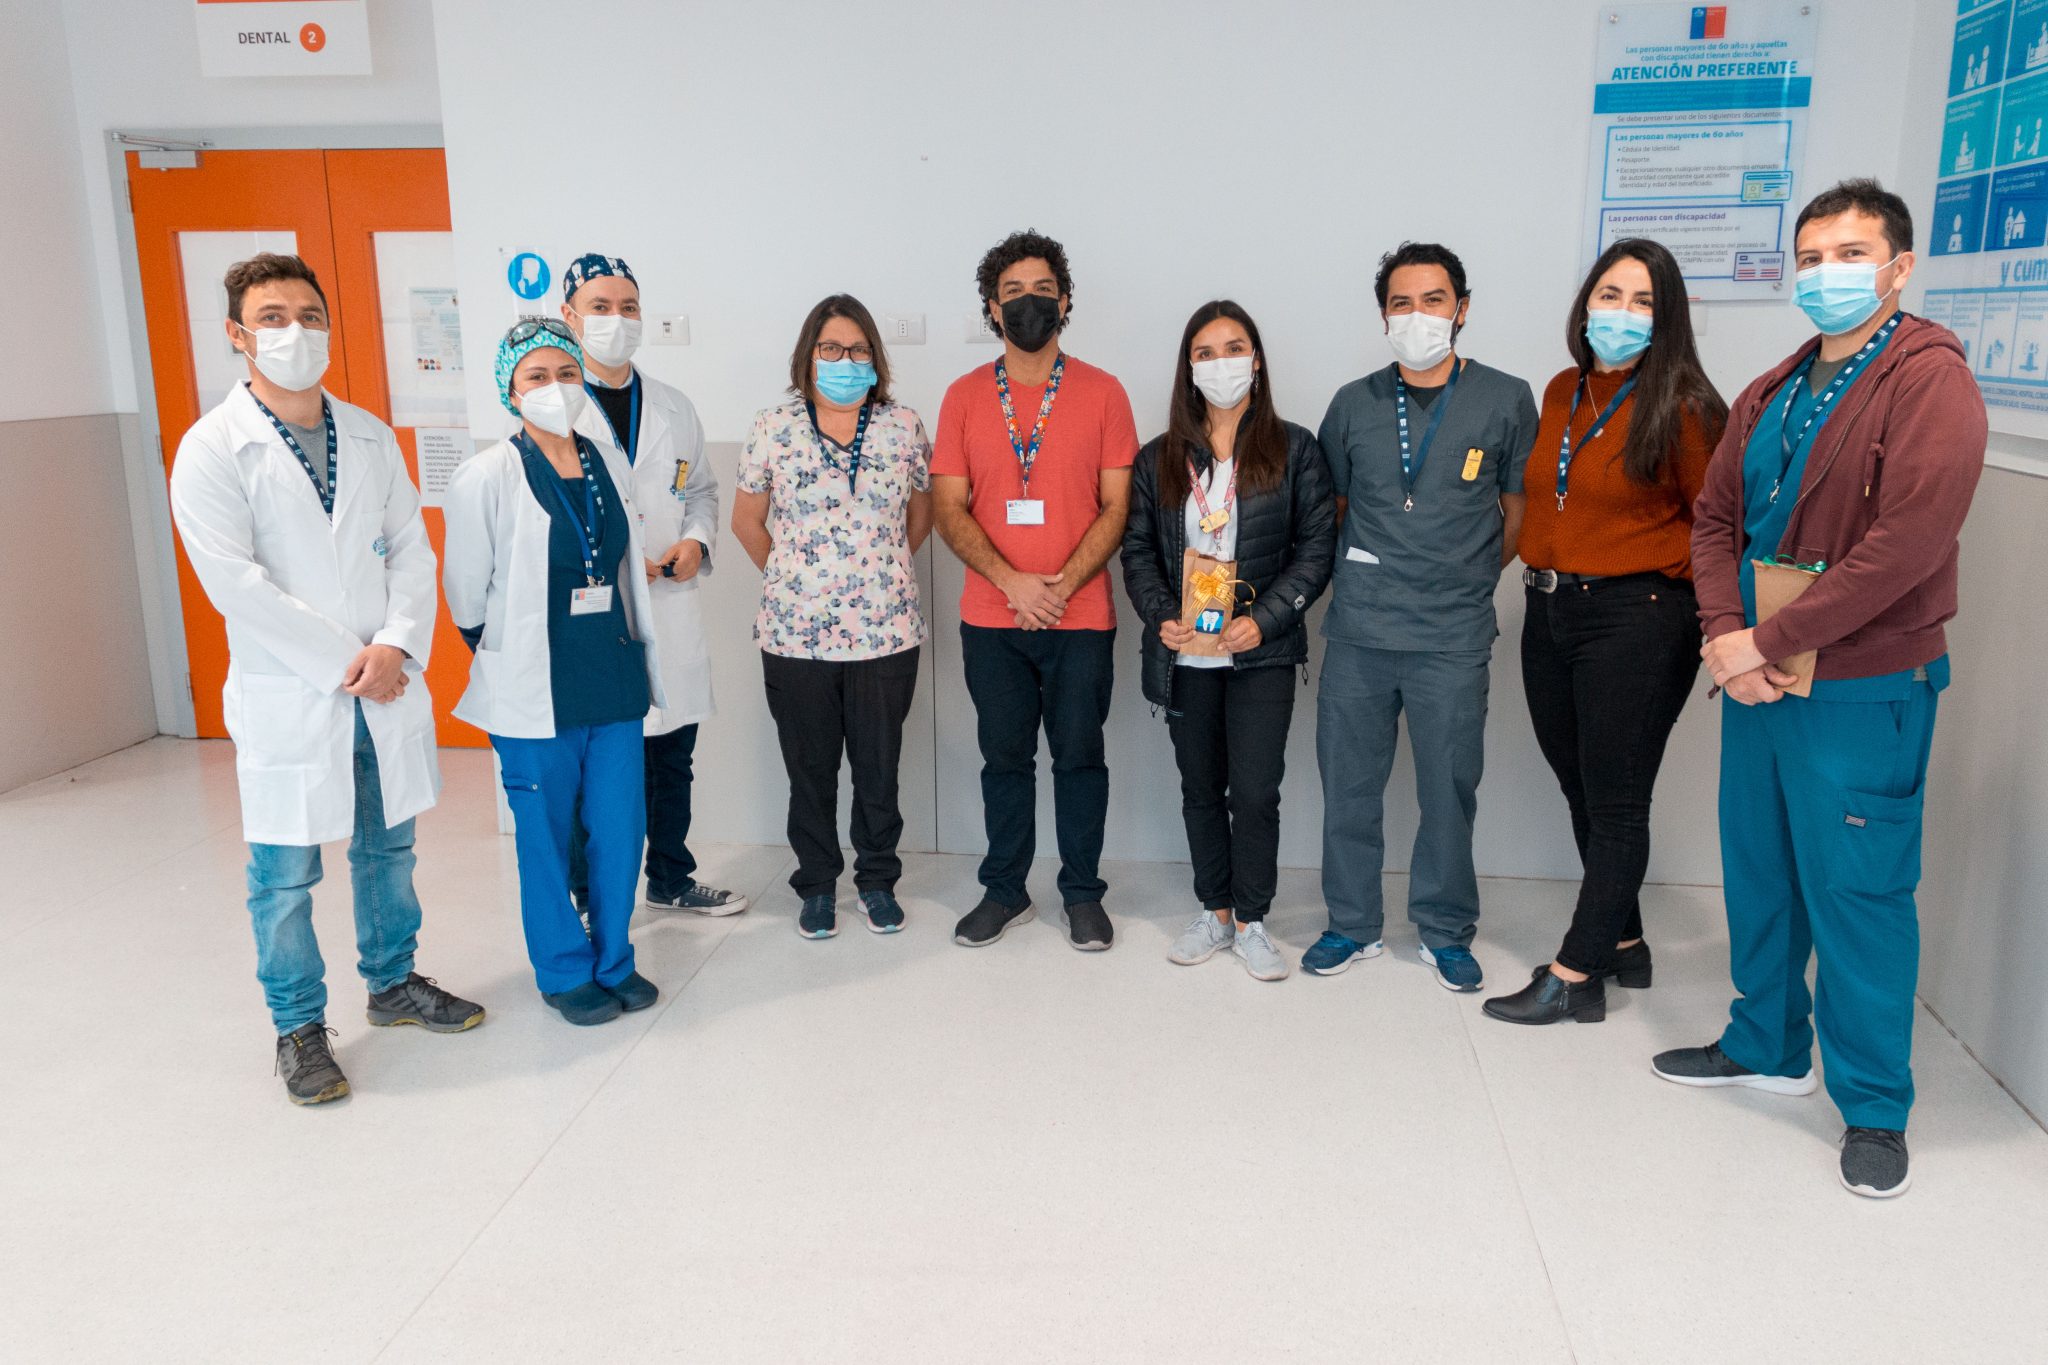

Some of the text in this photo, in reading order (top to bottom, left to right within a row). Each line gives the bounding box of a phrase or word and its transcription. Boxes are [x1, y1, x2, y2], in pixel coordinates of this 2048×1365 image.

[238, 30, 317, 44] DENTAL 2
[1639, 46, 1673, 55] personas
[1674, 44, 1706, 53] mayores
[1707, 42, 1717, 50] de
[1730, 41, 1749, 49] años
[1756, 40, 1788, 49] aquellas
[1656, 52, 1704, 61] discapacidad
[1612, 61, 1797, 80] ATENCIÓN PREFERENTE
[1617, 115, 1625, 123] Se
[1643, 113, 1674, 122] presentar
[1688, 112, 1698, 120] de
[1698, 112, 1708, 120] los
[1708, 112, 1742, 121] siguientes
[1630, 132, 1665, 142] personas
[1666, 131, 1700, 141] mayores
[1713, 130, 1724, 138] 60
[1623, 214, 1657, 223] personas
[1674, 212, 1726, 222] discapacidad
[2001, 261, 2011, 288] y
